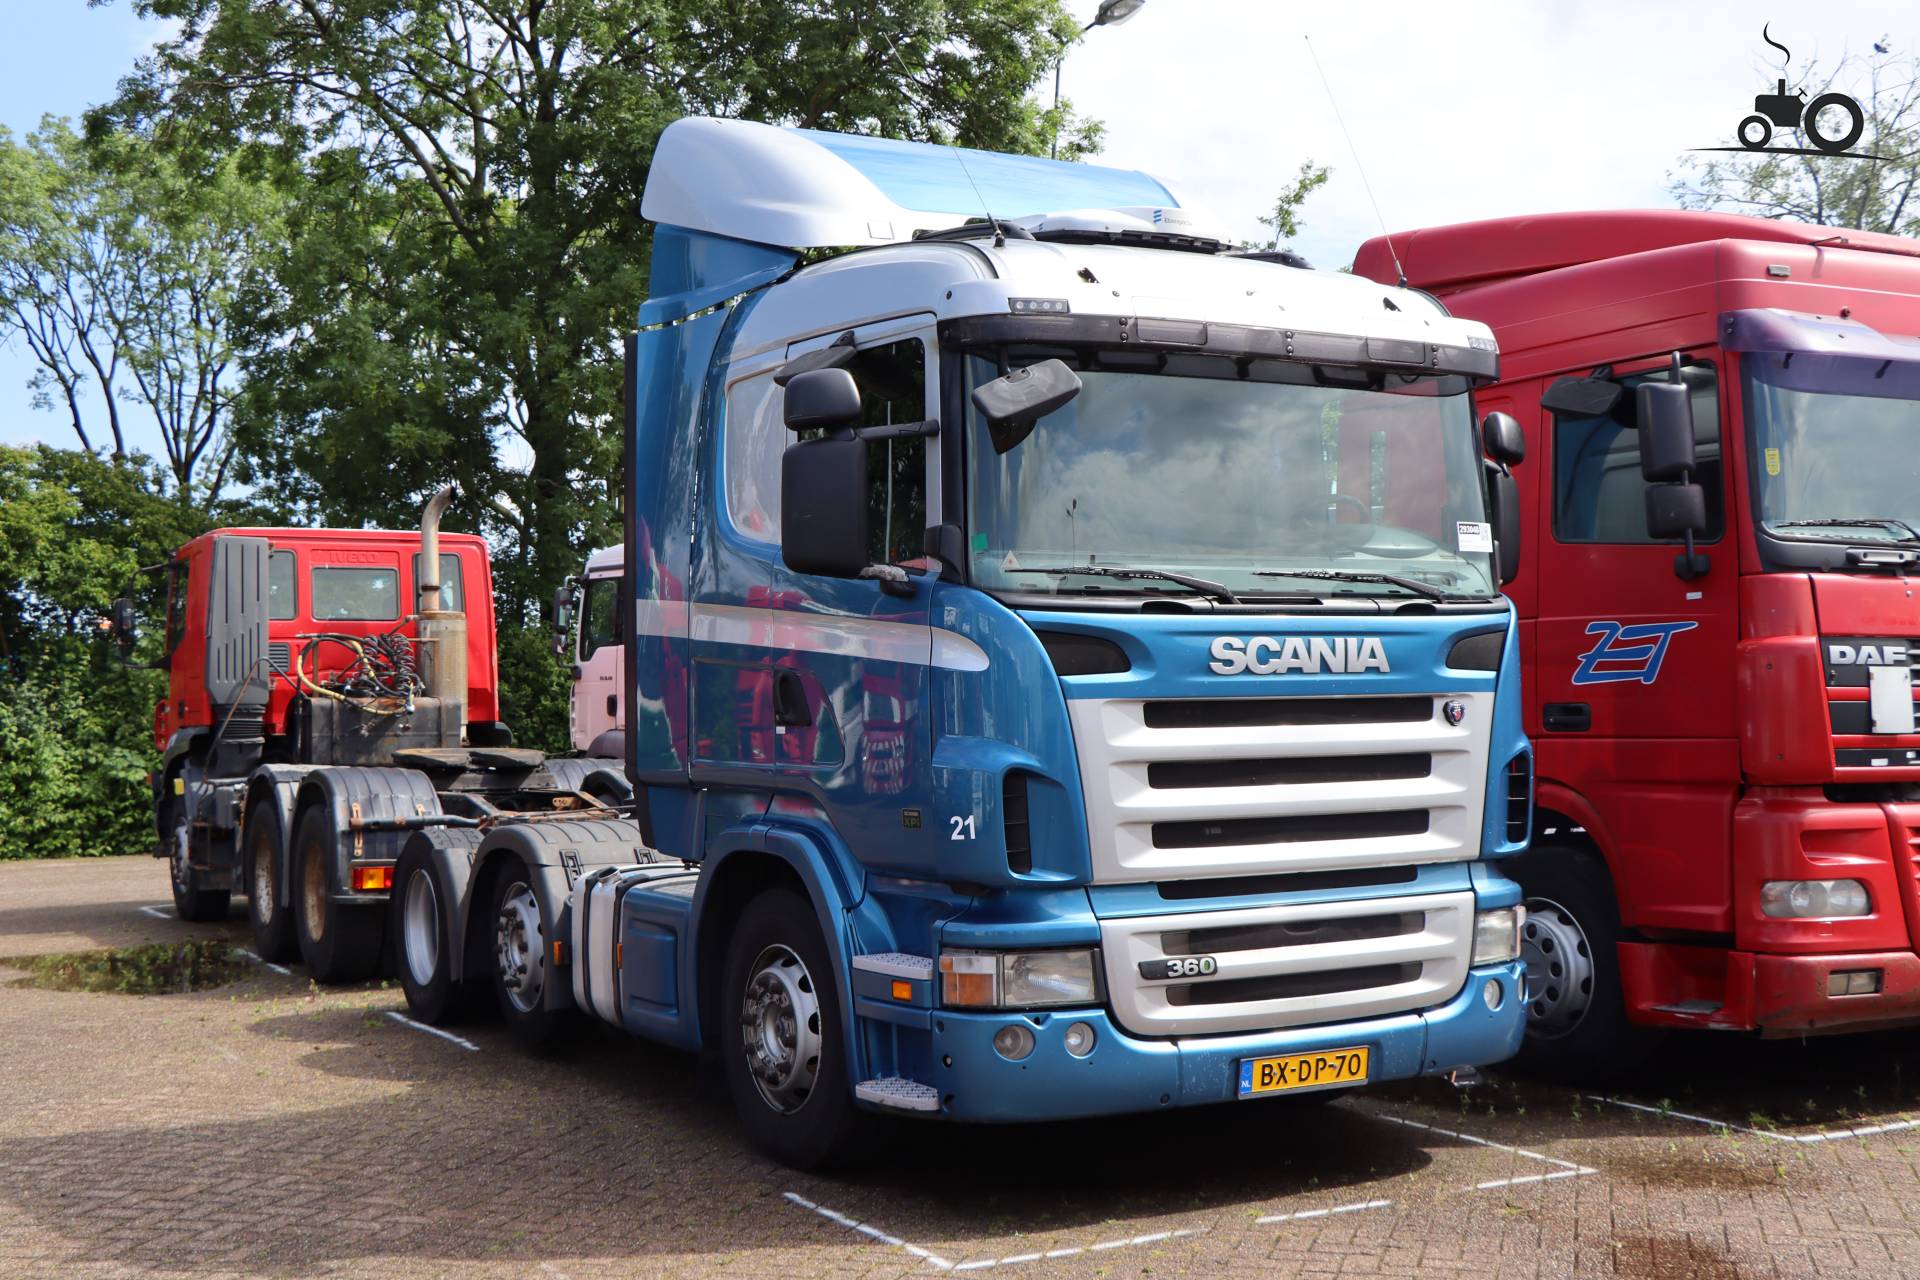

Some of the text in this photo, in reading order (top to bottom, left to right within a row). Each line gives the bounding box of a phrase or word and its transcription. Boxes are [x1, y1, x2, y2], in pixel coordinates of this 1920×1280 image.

[329, 552, 376, 563] IVECO
[1209, 636, 1391, 675] SCANIA
[1829, 645, 1907, 665] DAF
[950, 815, 976, 840] 21
[1167, 958, 1215, 977] 360
[1261, 1053, 1361, 1087] BX-DP-70
[1241, 1080, 1251, 1088] NL
